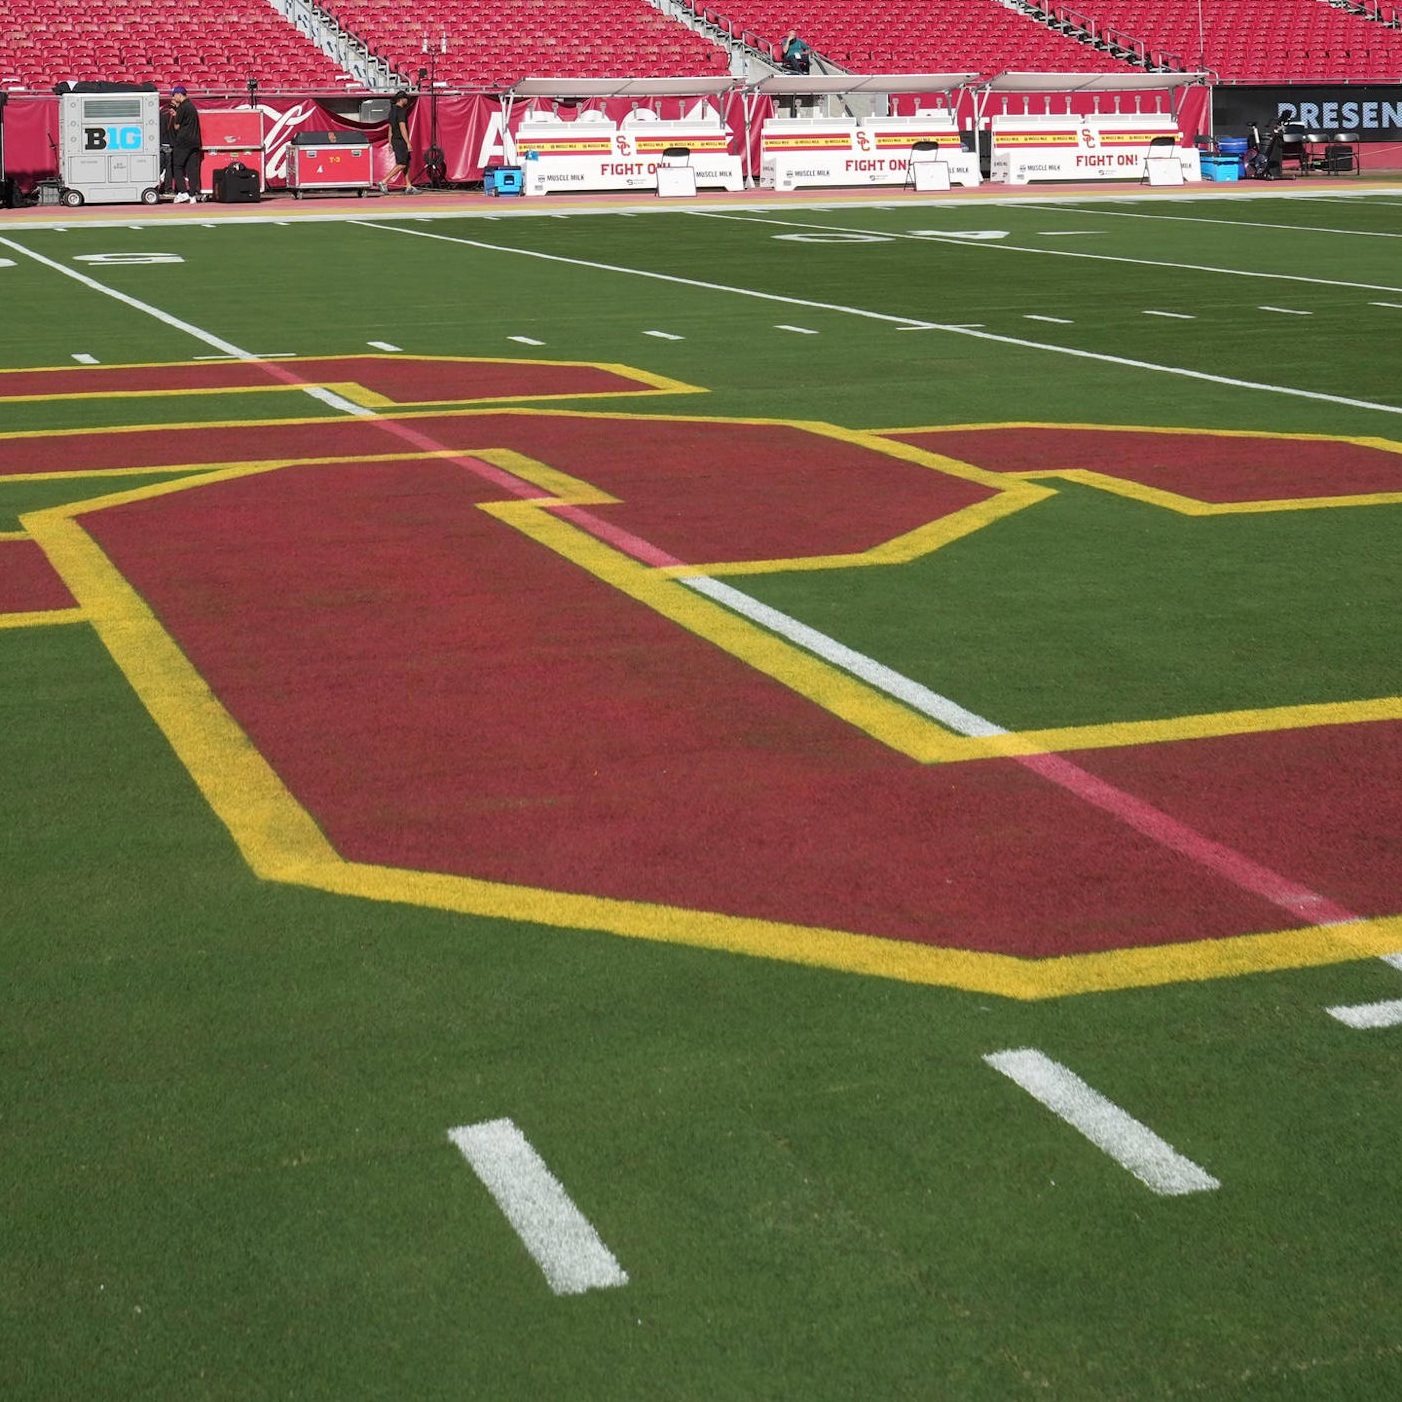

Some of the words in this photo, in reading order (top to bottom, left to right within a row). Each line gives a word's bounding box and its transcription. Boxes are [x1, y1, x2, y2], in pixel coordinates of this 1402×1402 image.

[856, 131, 871, 152] SC
[1082, 128, 1096, 149] SC
[616, 135, 632, 157] SC
[845, 159, 885, 172] FIGHT
[1076, 155, 1116, 167] FIGHT
[1117, 154, 1138, 166] ON!
[601, 163, 643, 175] FIGHT
[547, 174, 569, 182] MUSCLE
